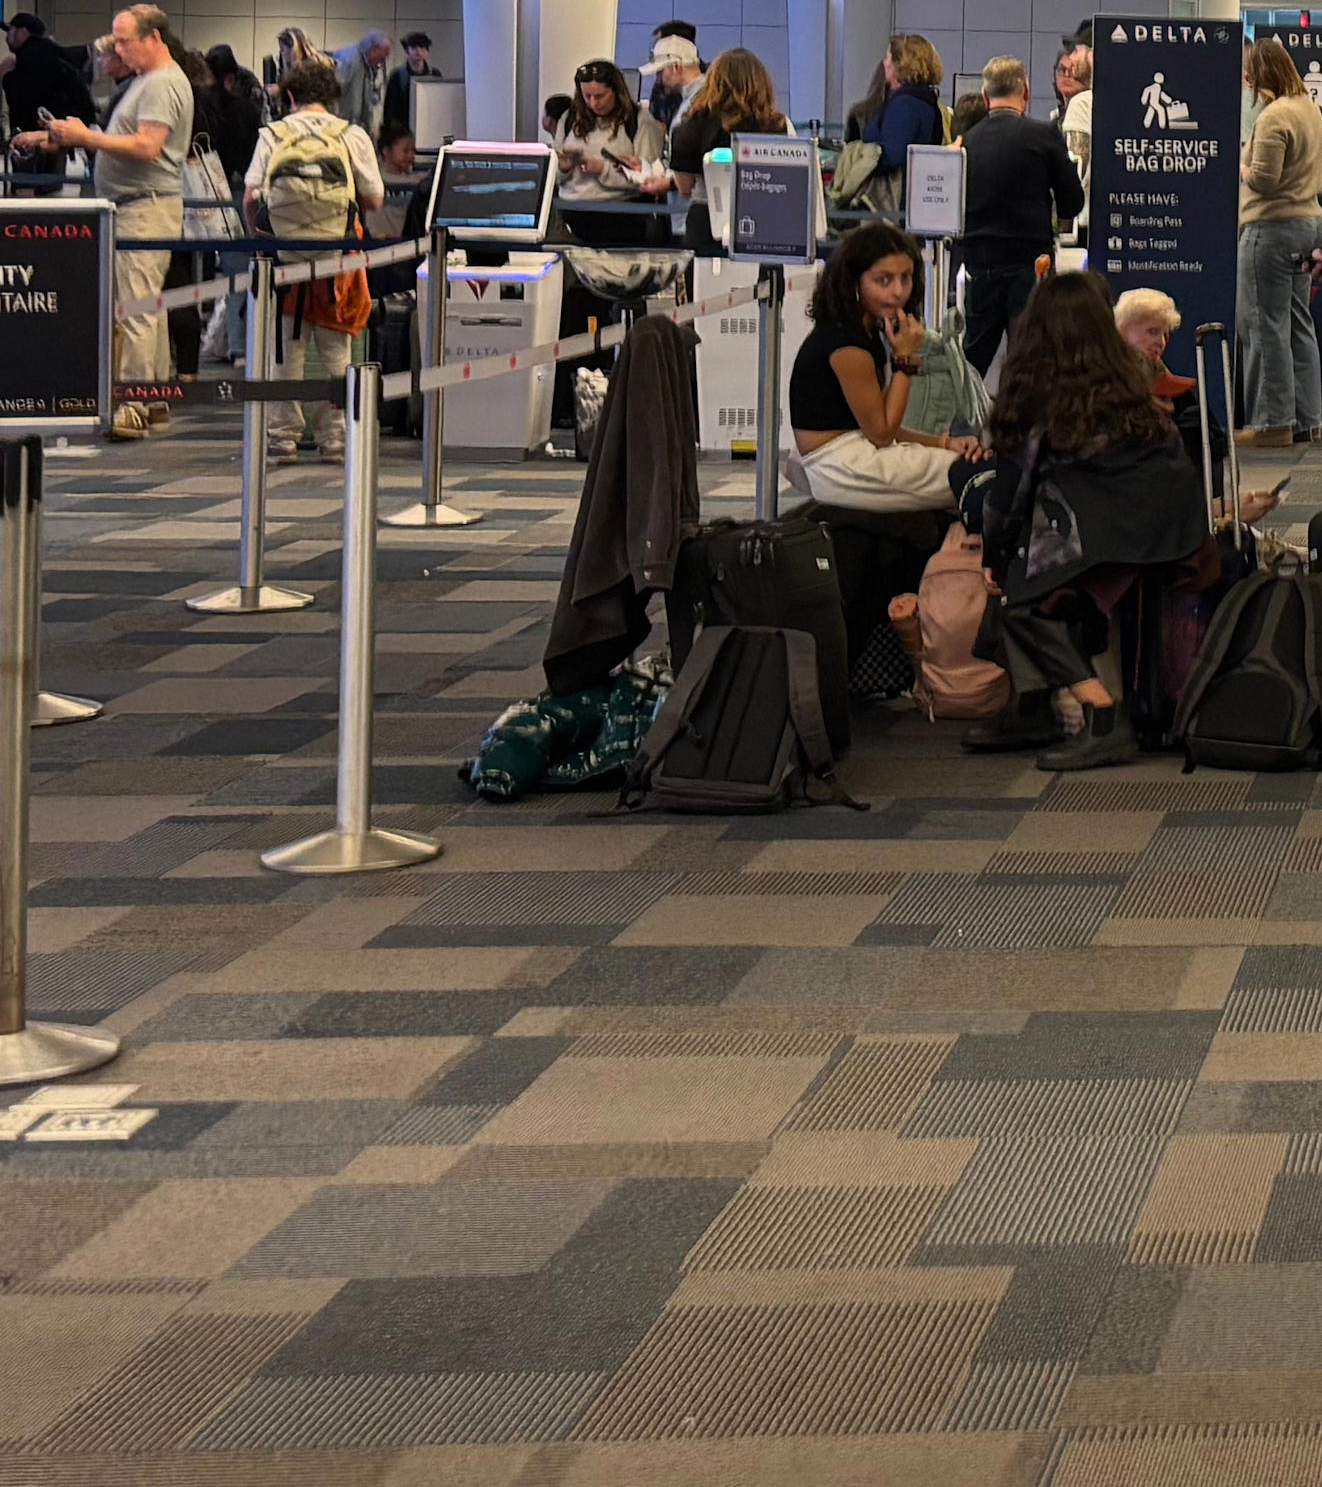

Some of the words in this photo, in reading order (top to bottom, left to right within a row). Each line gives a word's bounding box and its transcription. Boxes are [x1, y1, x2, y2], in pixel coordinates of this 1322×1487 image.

[1134, 24, 1208, 44] DELTA
[754, 148, 769, 157] AIR
[771, 149, 808, 158] CANADA
[1114, 138, 1219, 158] SELF-SERVICE
[1126, 155, 1159, 173] BAG
[1162, 156, 1208, 173] DROP
[1108, 193, 1145, 205] PLEASE
[1147, 193, 1179, 206] HAVE:
[4, 224, 94, 239] CANADA
[456, 346, 499, 357] DELTA
[113, 385, 184, 398] CANADA
[60, 398, 96, 410] GOLD
